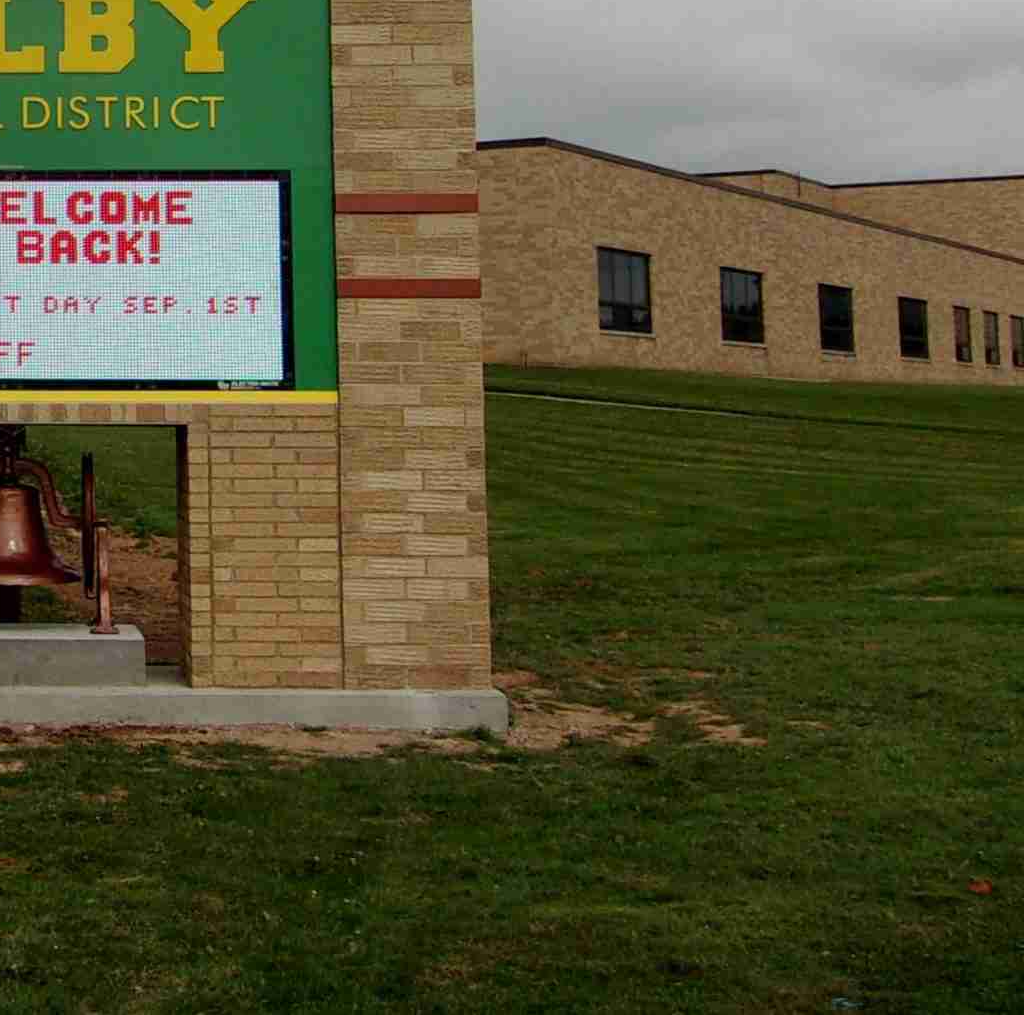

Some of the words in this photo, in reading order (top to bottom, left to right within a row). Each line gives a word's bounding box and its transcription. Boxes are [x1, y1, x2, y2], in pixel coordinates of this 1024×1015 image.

[21, 94, 225, 130] DISTRICT
[16, 229, 161, 265] BACK!
[43, 296, 101, 314] DAY
